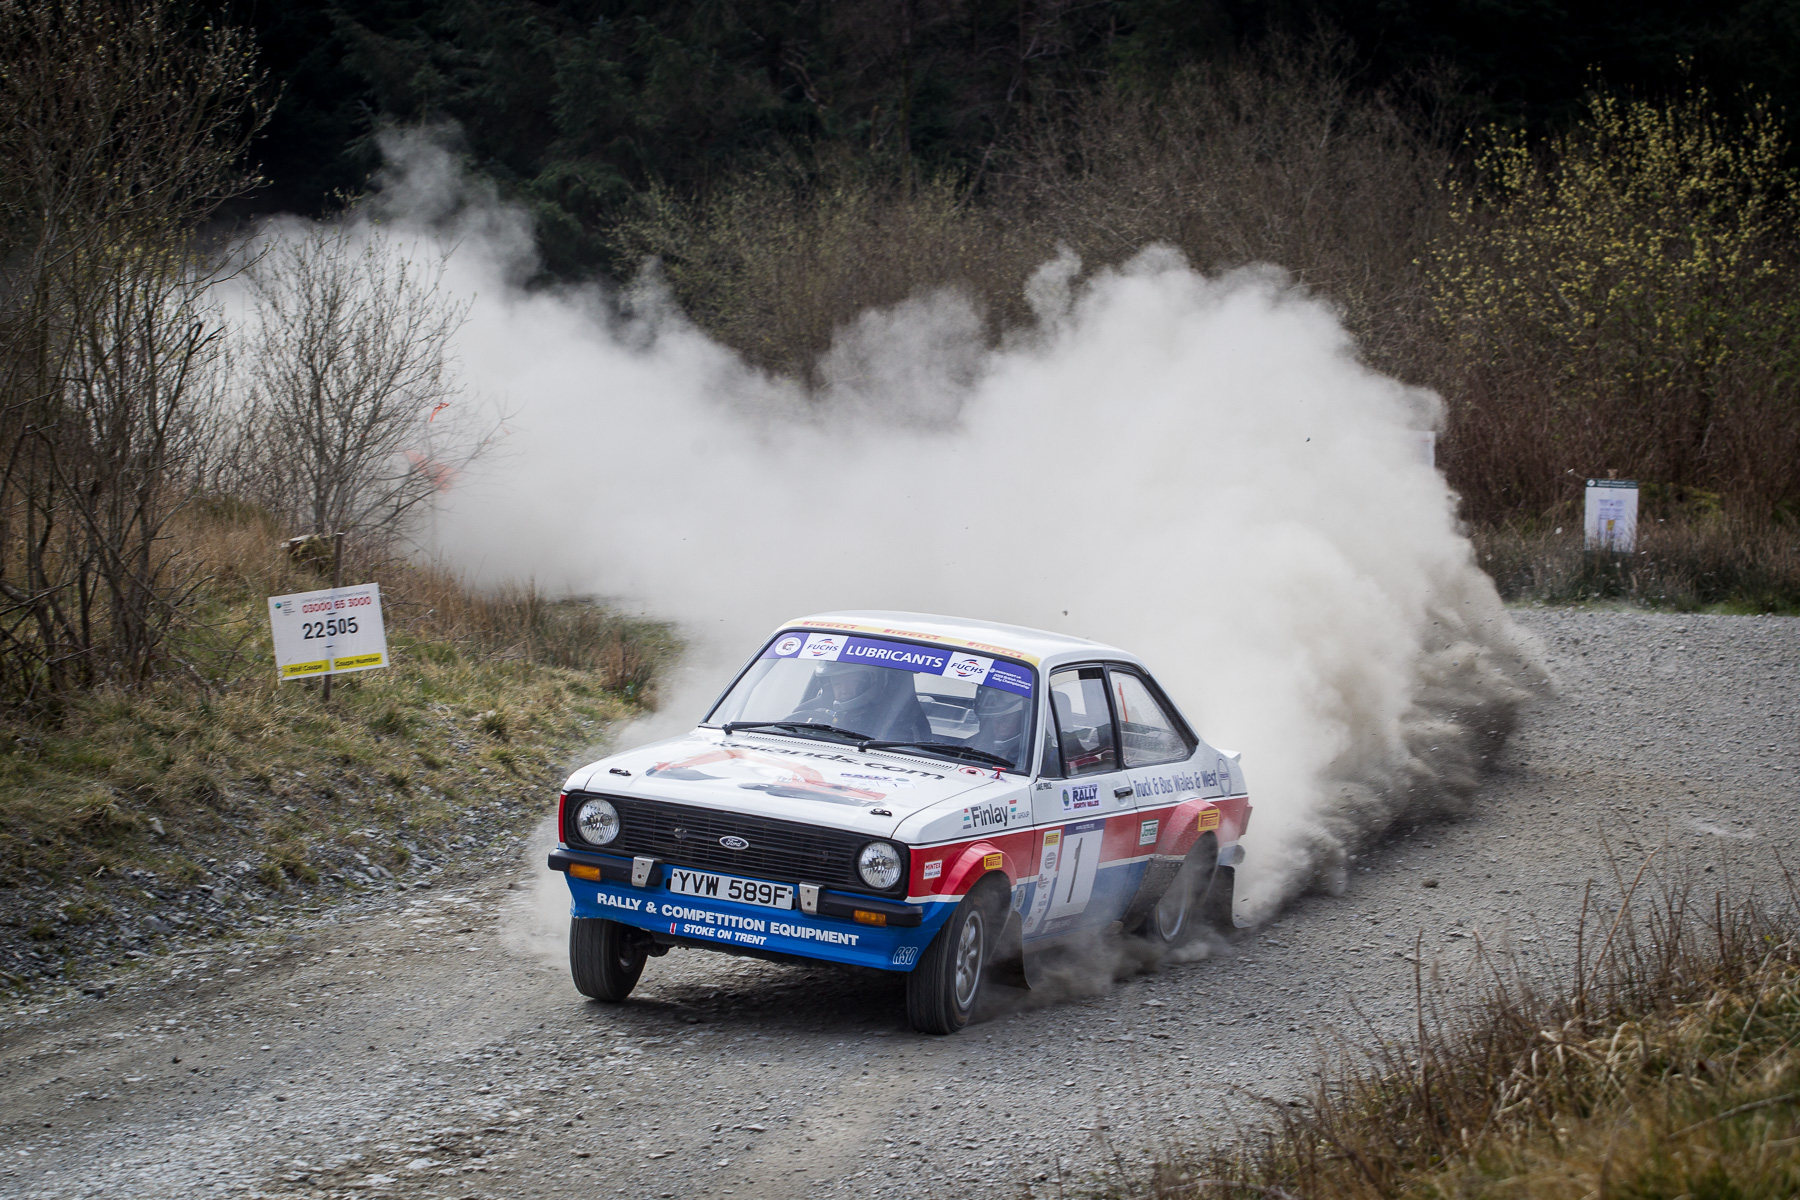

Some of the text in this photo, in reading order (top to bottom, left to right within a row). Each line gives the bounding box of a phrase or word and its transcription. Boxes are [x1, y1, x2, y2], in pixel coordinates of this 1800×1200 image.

[348, 596, 372, 607] 3000
[302, 617, 359, 640] 22505
[807, 644, 840, 652] FUCHS
[846, 645, 944, 668] LUBRICANTS
[950, 662, 985, 674] FUCHS
[1072, 787, 1098, 802] RALLY
[1133, 777, 1153, 798] Truck
[1159, 776, 1174, 794] Bus
[1172, 772, 1195, 791] Wales
[1200, 769, 1218, 788] West
[970, 804, 1008, 827] Finlay
[1017, 811, 1030, 819] GROUP
[725, 838, 743, 847] Ford
[925, 862, 942, 871] MINTEX
[1066, 837, 1083, 904] 1
[678, 871, 788, 905] YVW 589F
[597, 892, 859, 946] RALLY & COMPETITION EQUIPMENT
[683, 923, 767, 946] STOKE ON TRENT
